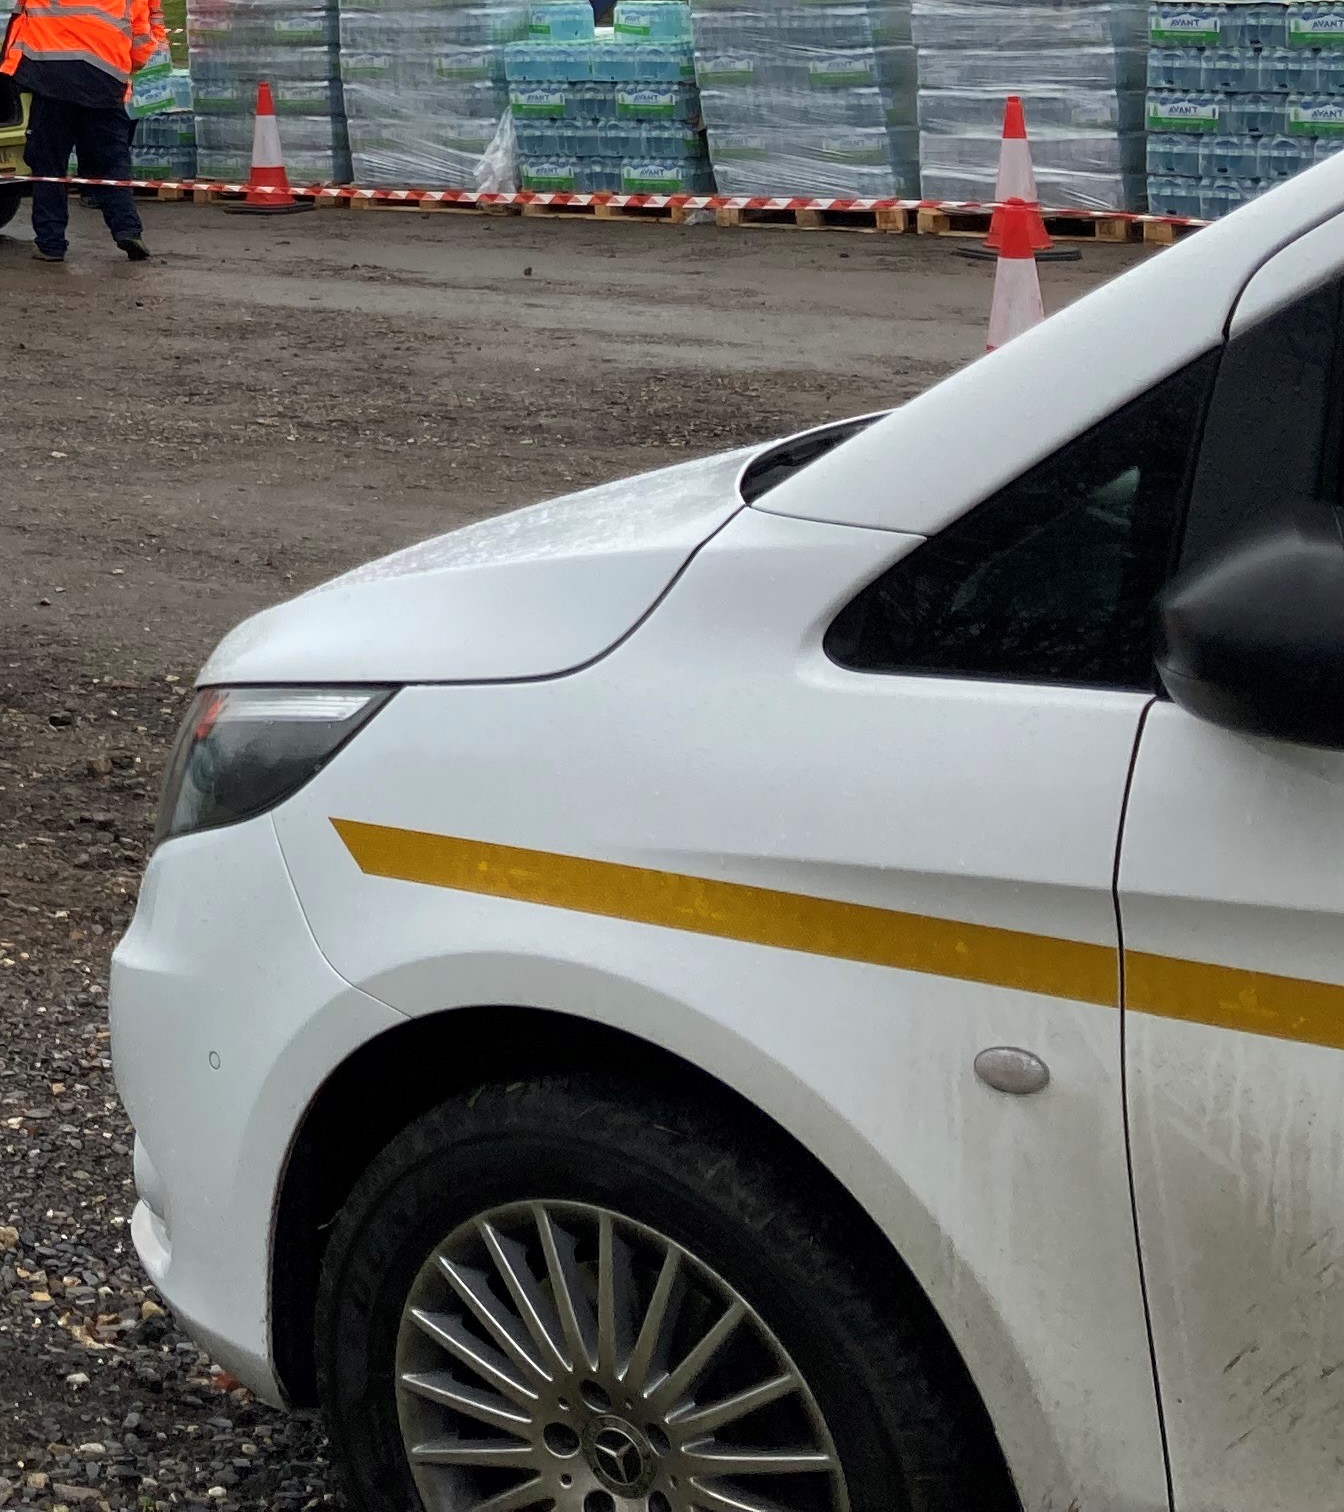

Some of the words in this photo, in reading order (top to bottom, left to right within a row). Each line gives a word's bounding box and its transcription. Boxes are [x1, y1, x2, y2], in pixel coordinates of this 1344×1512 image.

[1170, 18, 1200, 27] AVANT
[1168, 106, 1198, 114] AVANT
[1312, 110, 1344, 118] AVANT
